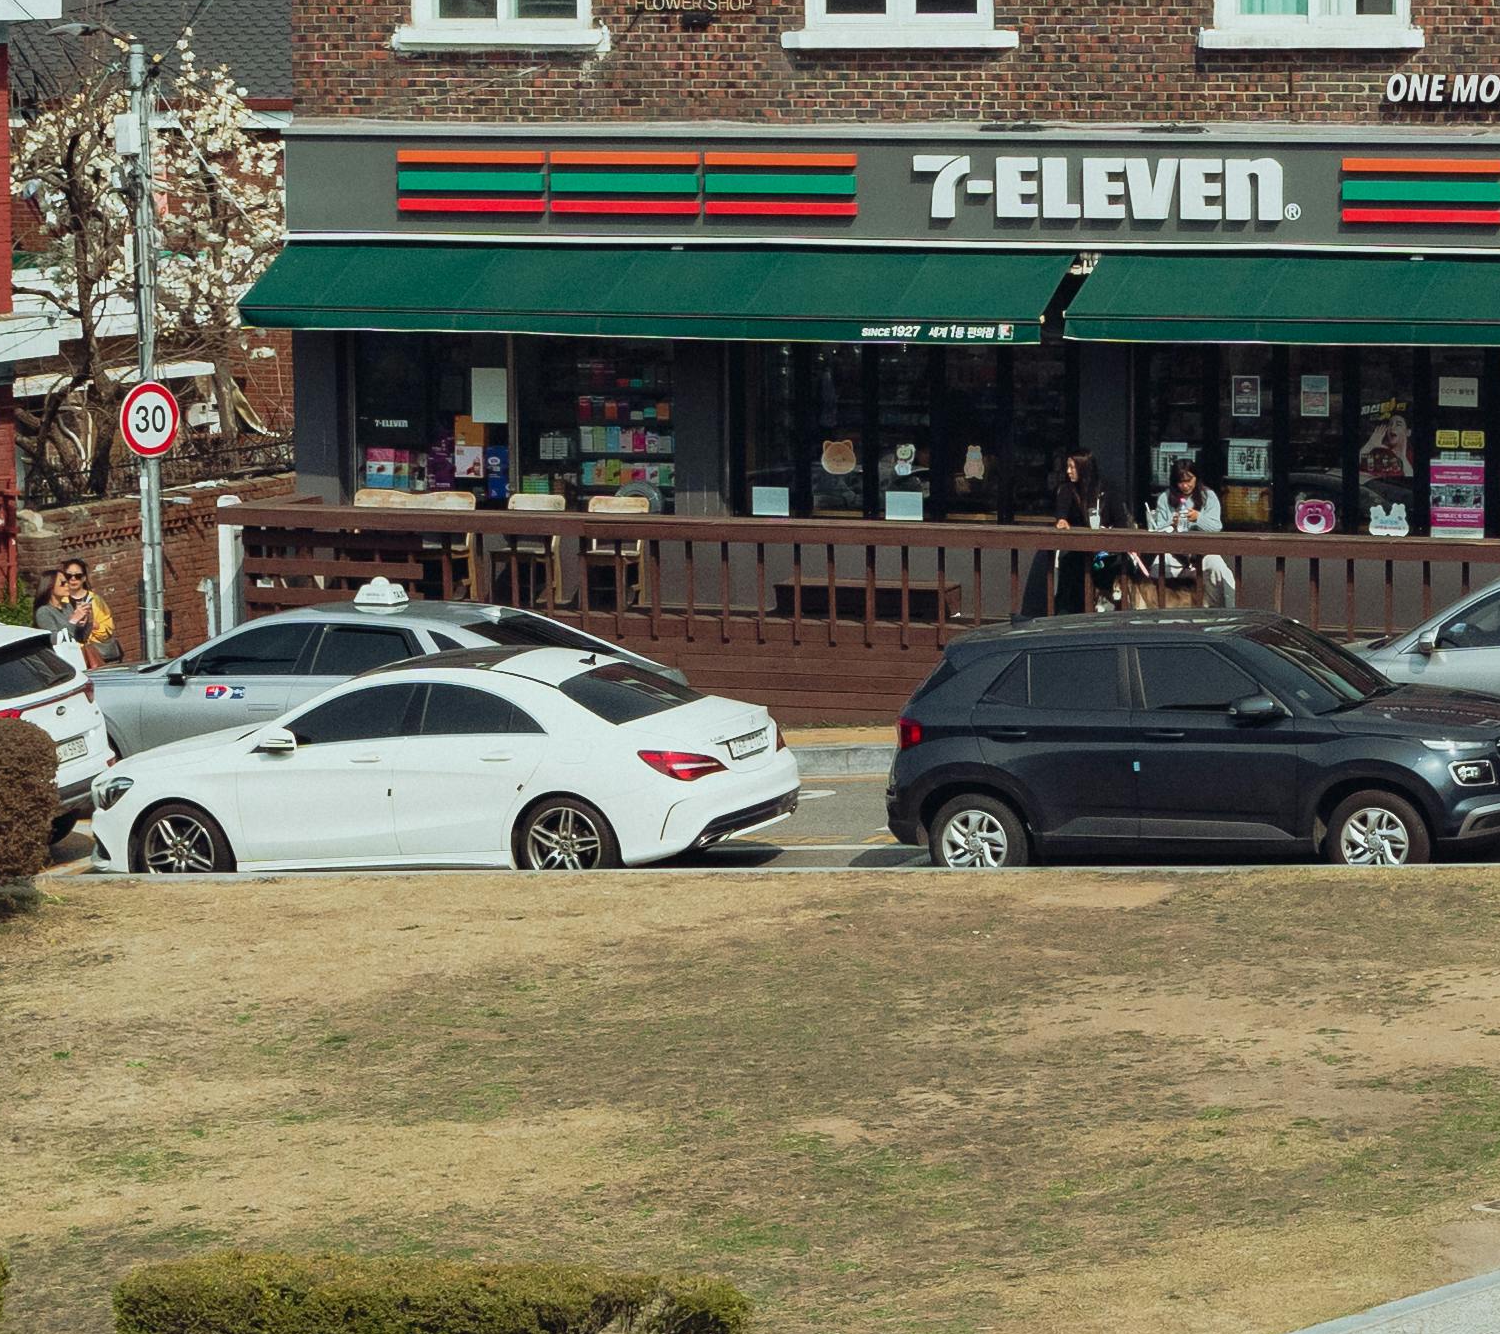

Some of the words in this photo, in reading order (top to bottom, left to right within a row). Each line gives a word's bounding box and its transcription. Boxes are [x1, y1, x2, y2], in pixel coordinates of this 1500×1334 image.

[1387, 72, 1446, 103] ONE
[861, 327, 891, 337] SINCE
[891, 325, 921, 338] 1927
[928, 326, 949, 338] 세계
[135, 404, 167, 434] 30
